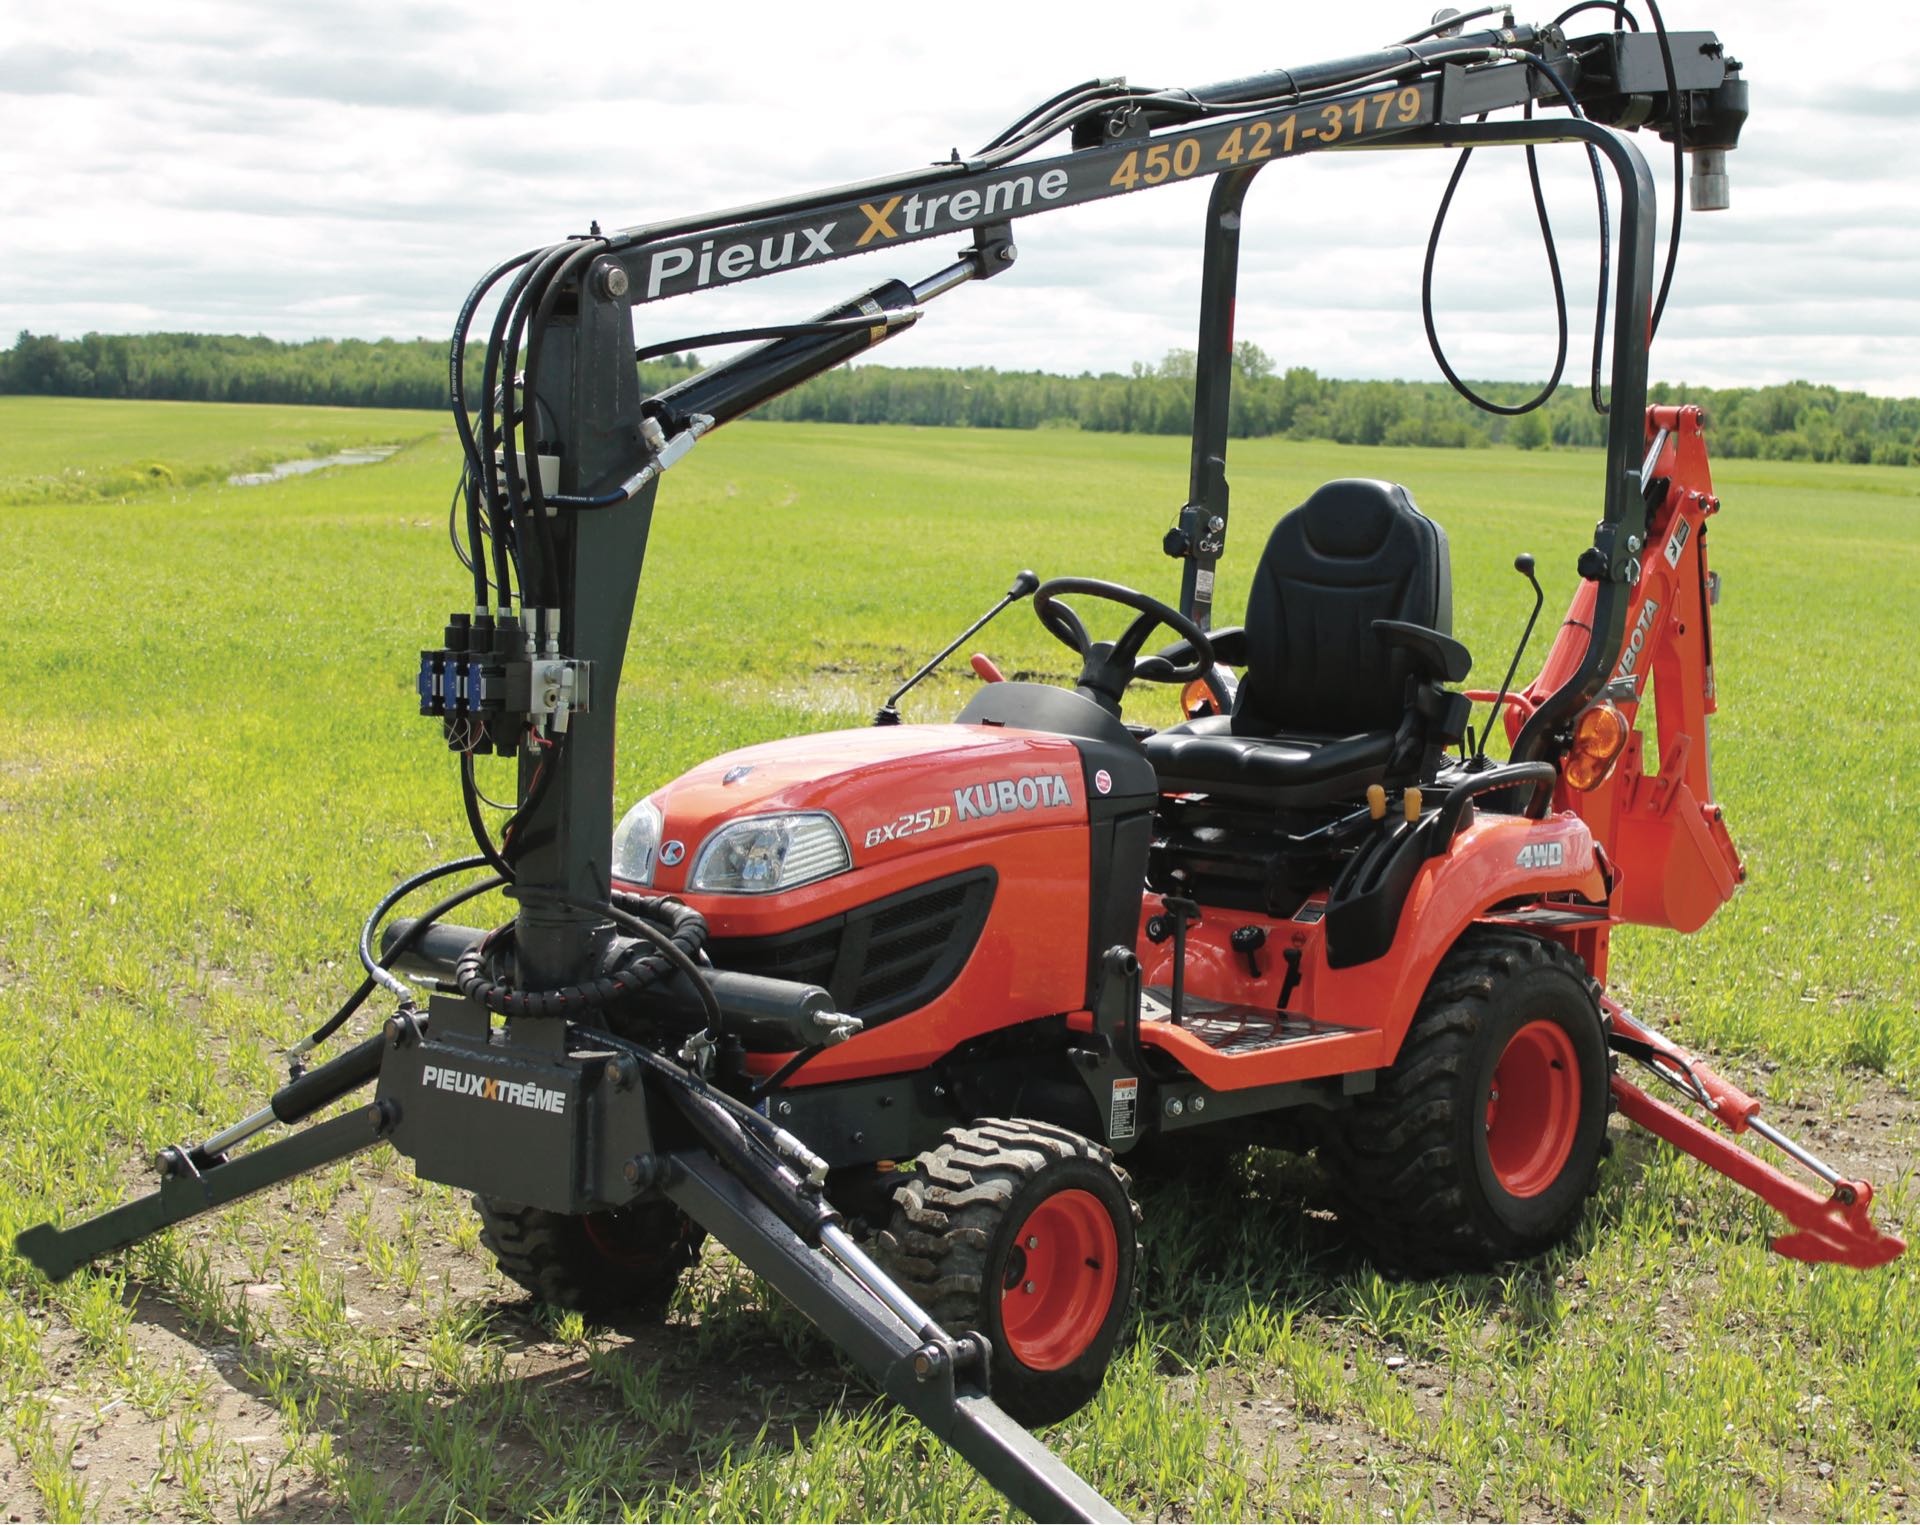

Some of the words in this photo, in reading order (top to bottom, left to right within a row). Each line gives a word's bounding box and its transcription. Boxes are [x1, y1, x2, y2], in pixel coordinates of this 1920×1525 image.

[647, 221, 838, 298] Pieux
[855, 168, 1069, 247] Xtreme
[1110, 138, 1201, 190] 450
[1216, 87, 1421, 165] 421-3179
[864, 805, 951, 849] BX25D
[953, 775, 1072, 822] KUBOTA
[1516, 842, 1564, 869] 4WD
[422, 1065, 567, 1114] PIEUXXTRÊME
